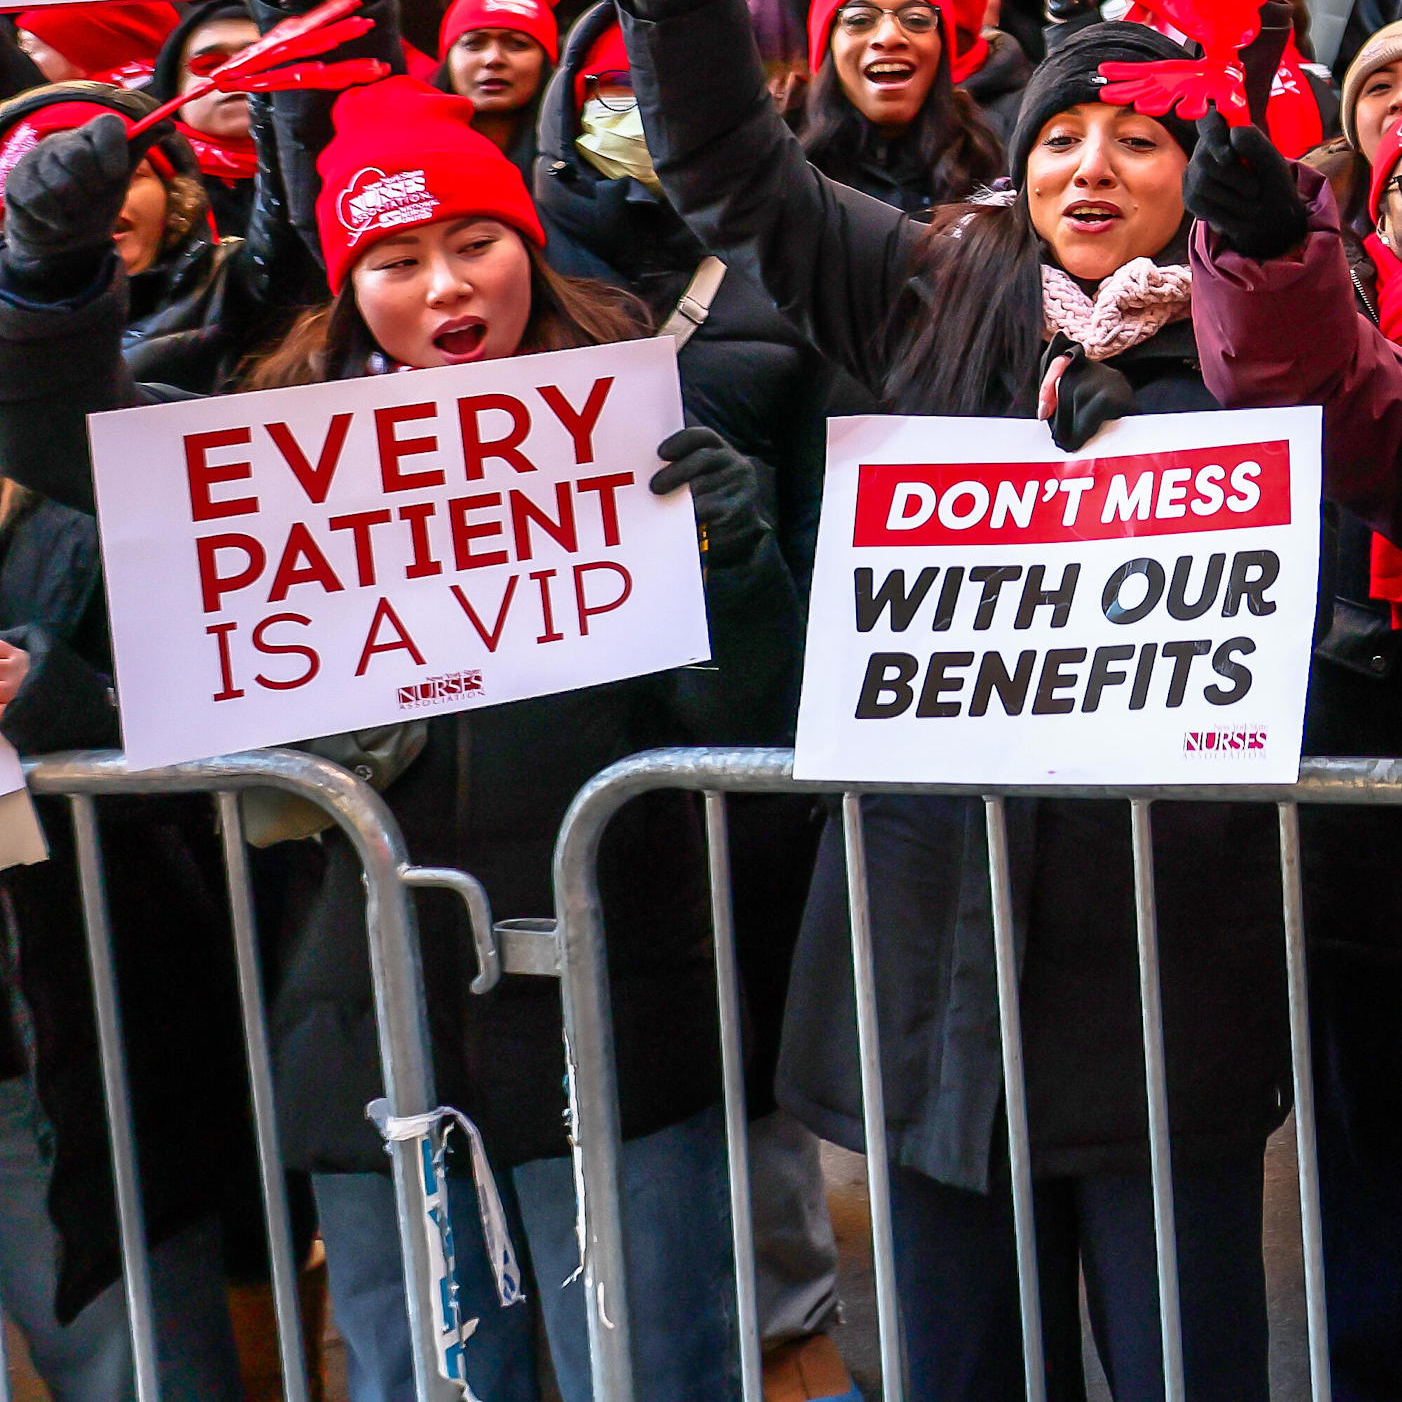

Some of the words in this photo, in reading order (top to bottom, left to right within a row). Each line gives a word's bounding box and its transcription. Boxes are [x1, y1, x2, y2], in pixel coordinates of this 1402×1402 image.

[182, 376, 615, 523] EVERY
[886, 476, 1095, 531] DON'T
[1100, 460, 1262, 525] MESS
[194, 470, 636, 614] PATIENT
[204, 611, 321, 703] IS
[354, 597, 427, 677] A
[449, 560, 633, 654] VIP
[853, 562, 1082, 634] WITH
[1100, 549, 1281, 626] OUR
[397, 674, 484, 705] NURSES
[854, 635, 1257, 720] BENEFITS
[1182, 730, 1268, 752] NURSES
